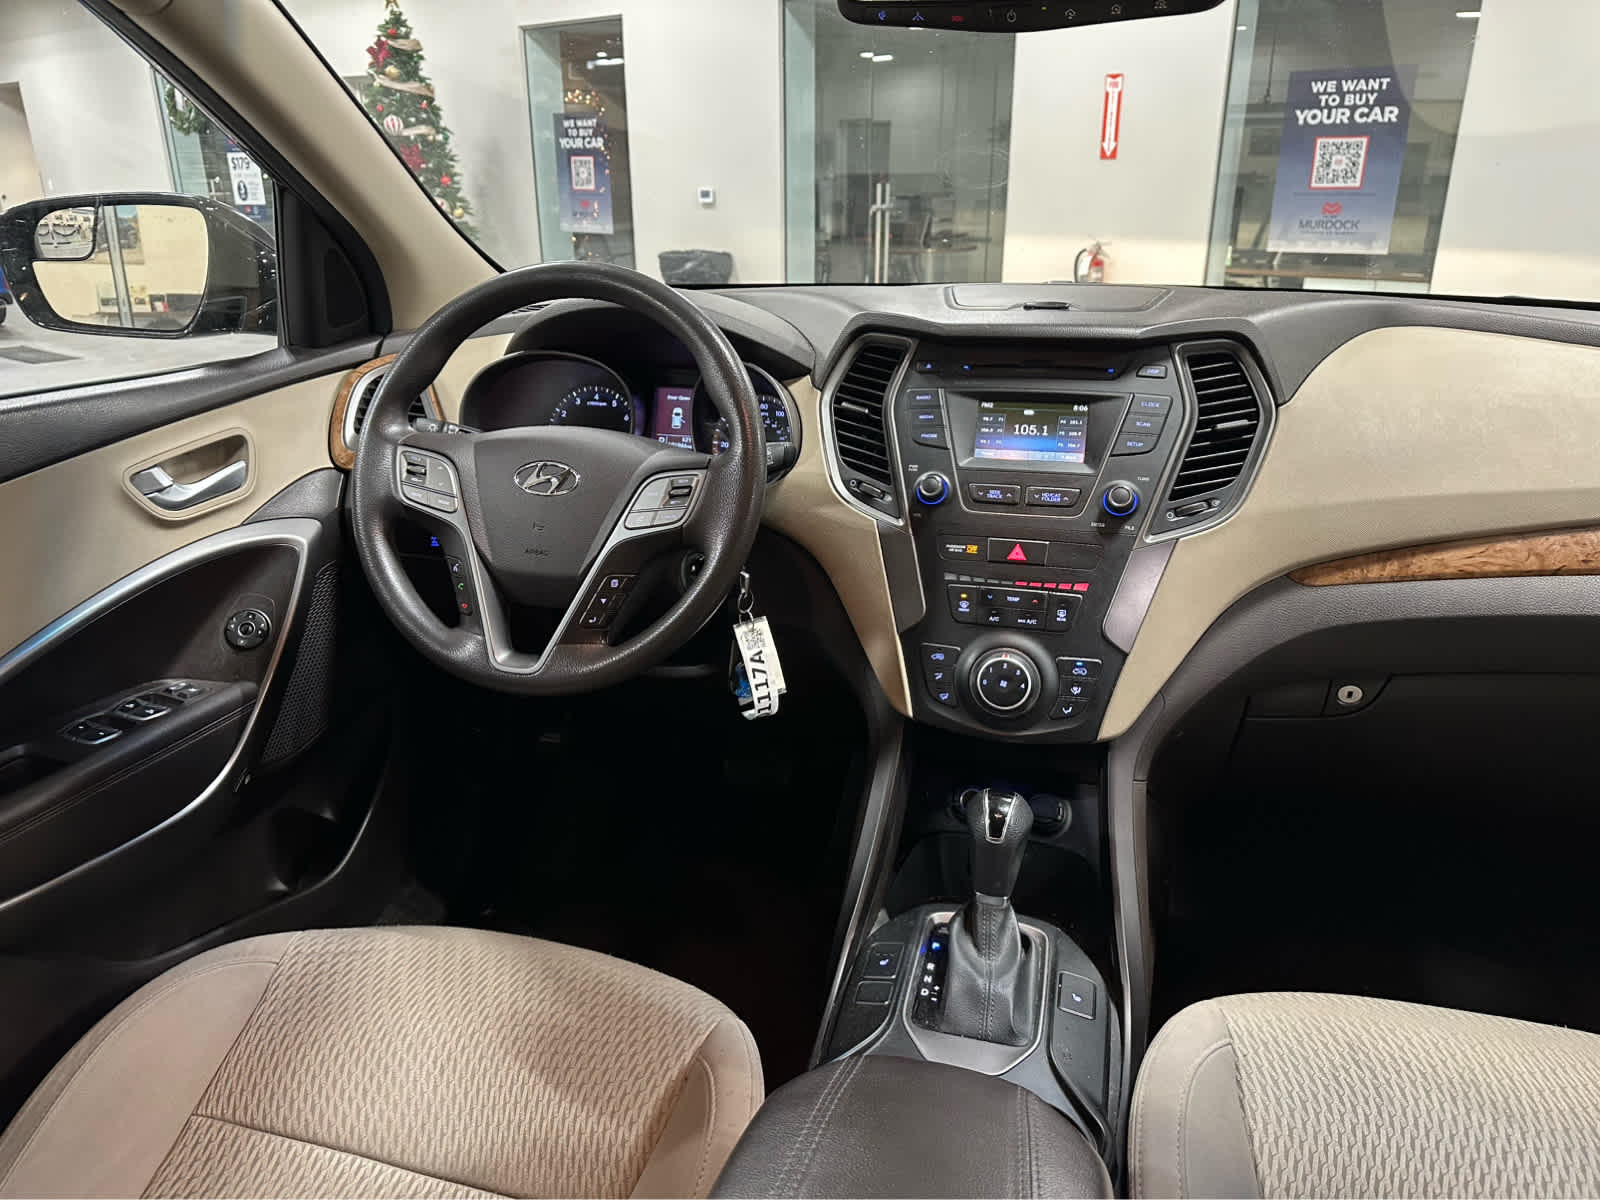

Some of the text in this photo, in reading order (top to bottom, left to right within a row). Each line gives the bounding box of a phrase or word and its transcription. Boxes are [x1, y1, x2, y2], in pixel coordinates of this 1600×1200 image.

[1311, 78, 1391, 93] WE WANT
[1319, 93, 1378, 106] TO BUY
[1295, 106, 1399, 125] YOUR CAR
[563, 118, 597, 128] WE WANT
[568, 128, 593, 137] TO BUY
[559, 136, 604, 149] YOUR CAR
[231, 157, 250, 171] $179
[1298, 219, 1360, 231] MURDOCK
[575, 397, 581, 405] 3
[612, 399, 617, 407] 5
[624, 413, 629, 421] 6
[1013, 424, 1049, 436] 105.1
[750, 650, 772, 713] 1117A
[924, 975, 932, 983] N
[921, 988, 929, 996] D
